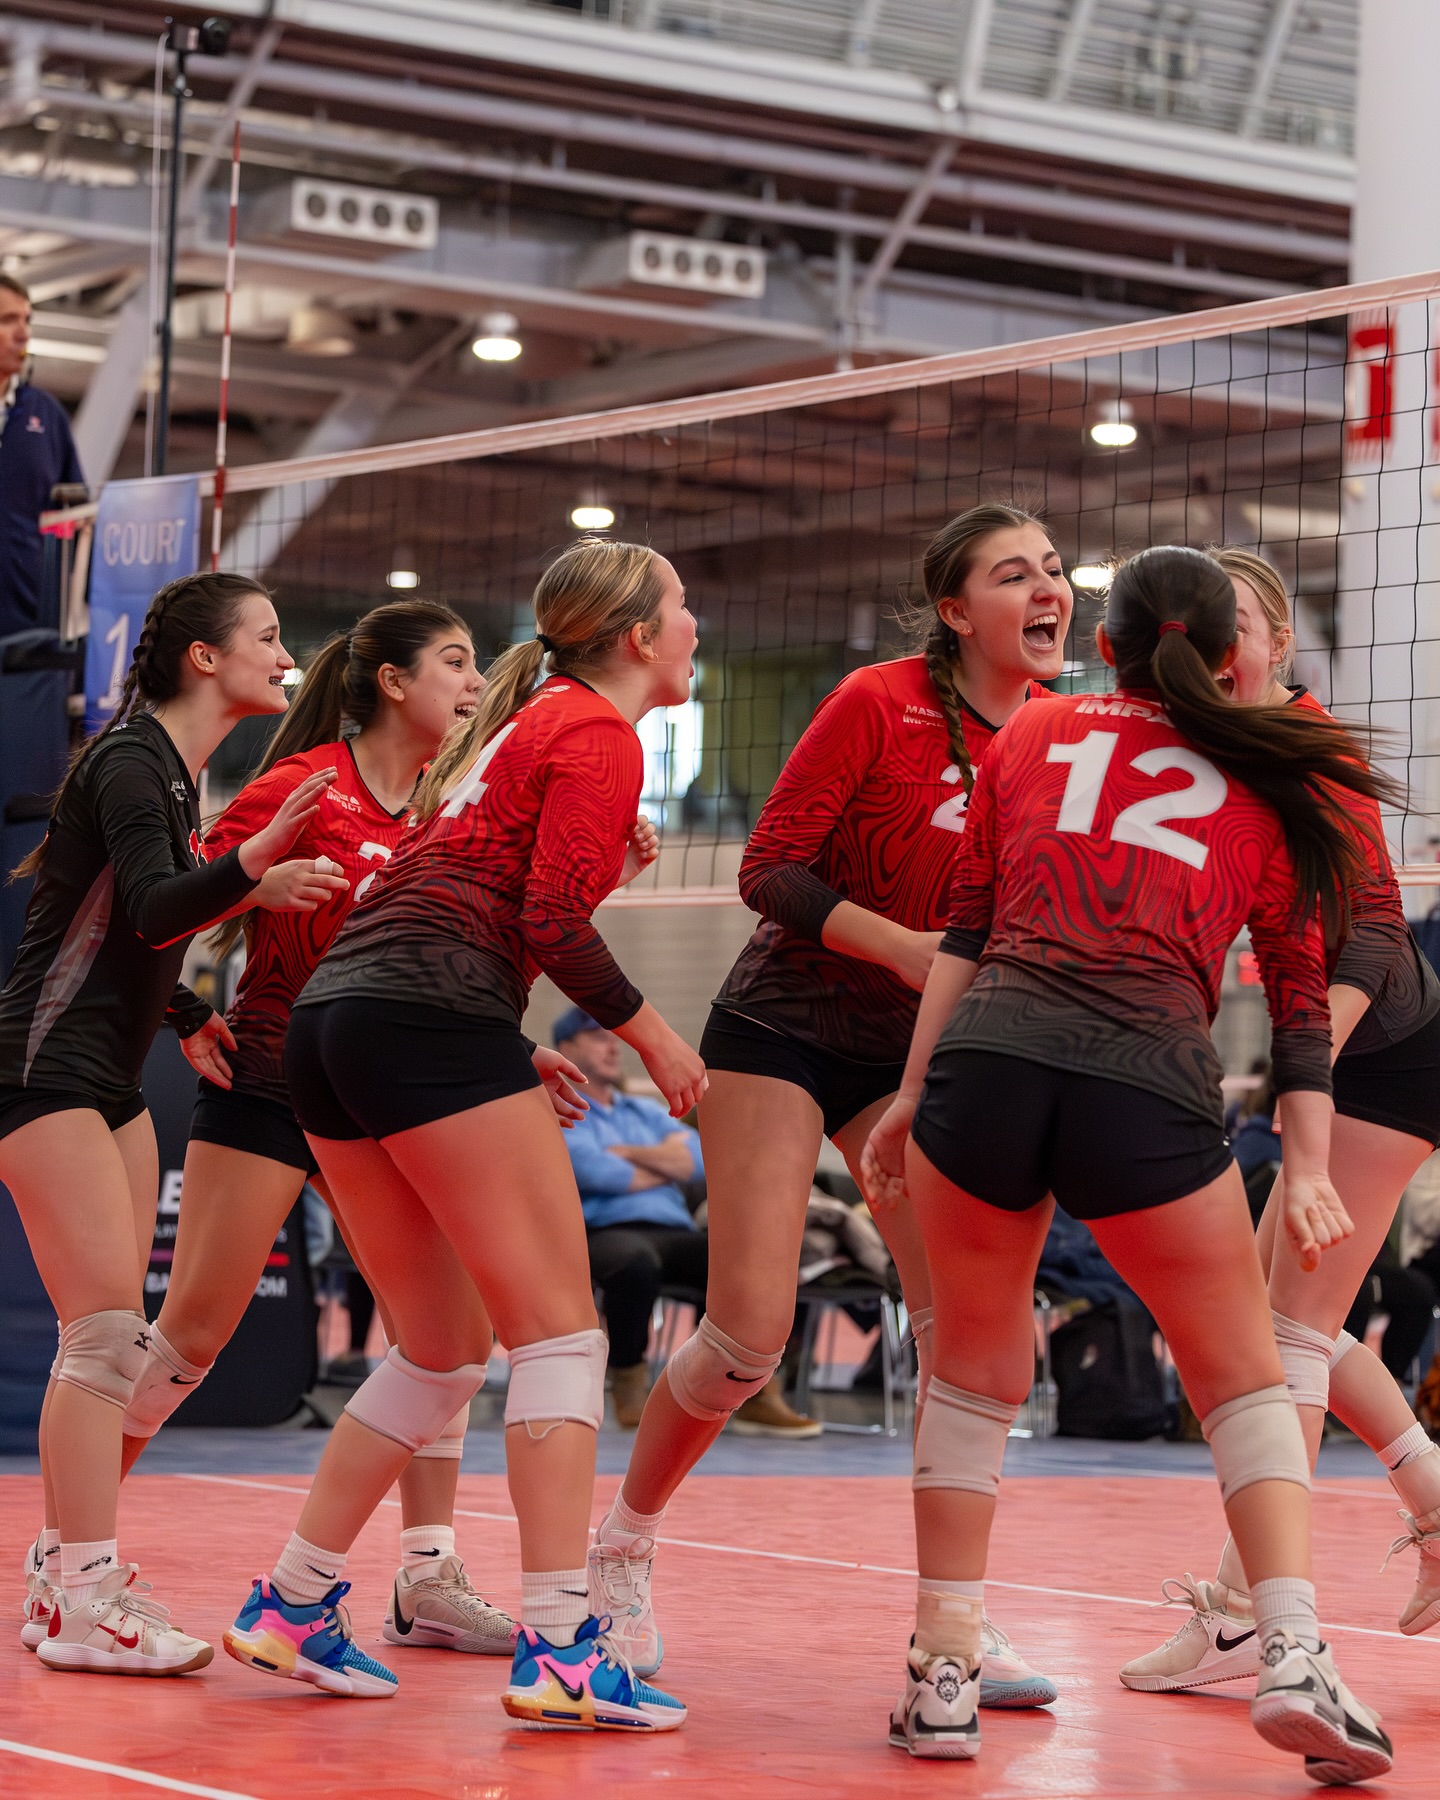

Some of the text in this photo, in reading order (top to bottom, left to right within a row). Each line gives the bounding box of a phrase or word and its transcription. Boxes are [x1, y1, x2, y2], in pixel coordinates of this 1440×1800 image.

[103, 519, 187, 566] COURT
[98, 613, 129, 709] 1
[1046, 730, 1228, 872] 12
